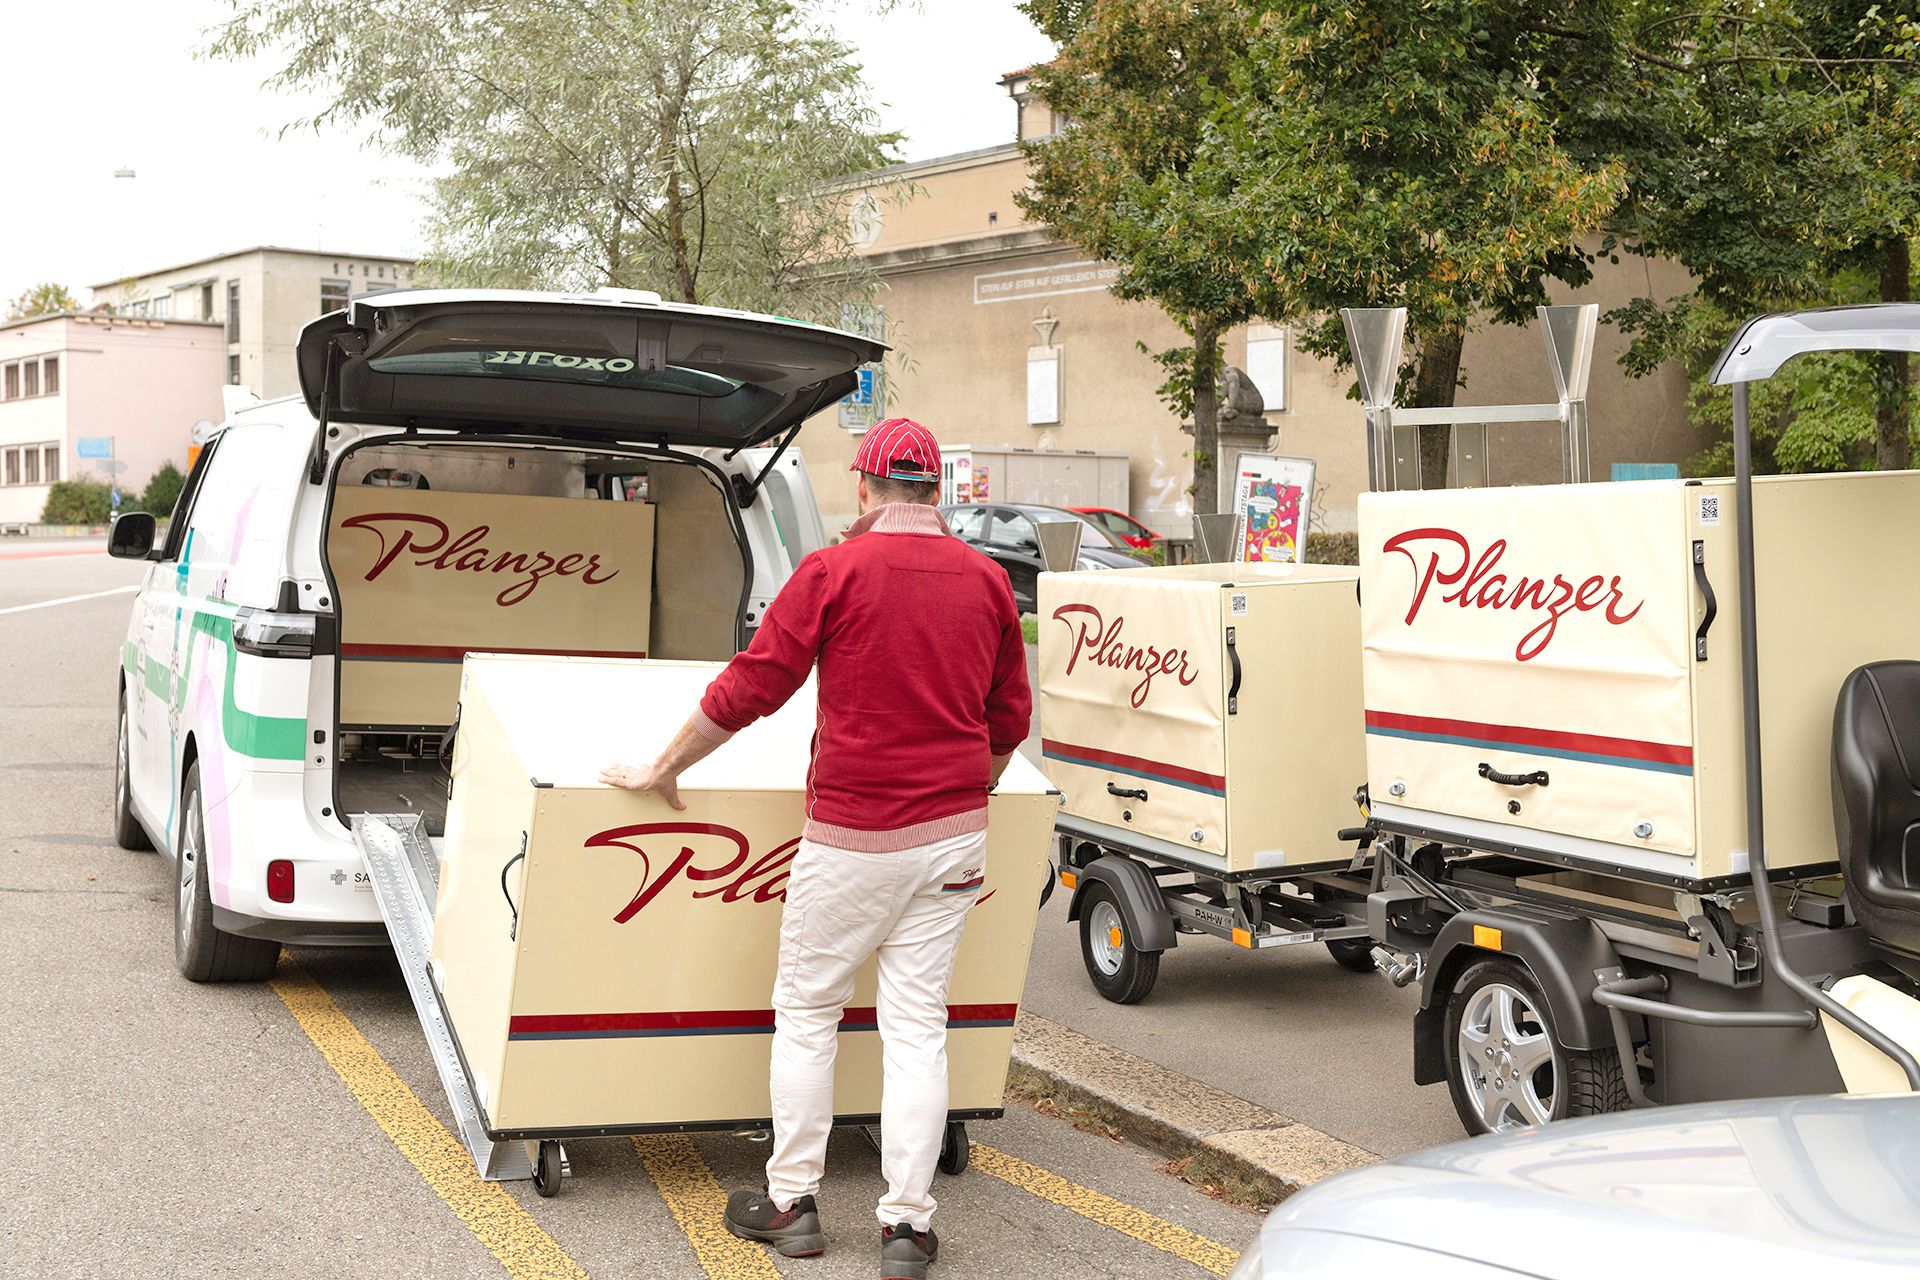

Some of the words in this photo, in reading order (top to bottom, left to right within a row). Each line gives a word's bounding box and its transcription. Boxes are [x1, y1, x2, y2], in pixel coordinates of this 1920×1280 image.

[341, 513, 620, 607] Planzer
[1236, 484, 1250, 562] ACHHALTIGKEITSTAGE
[1383, 528, 1645, 662] Planzer
[1053, 603, 1199, 709] Planzer
[354, 872, 372, 883] SA
